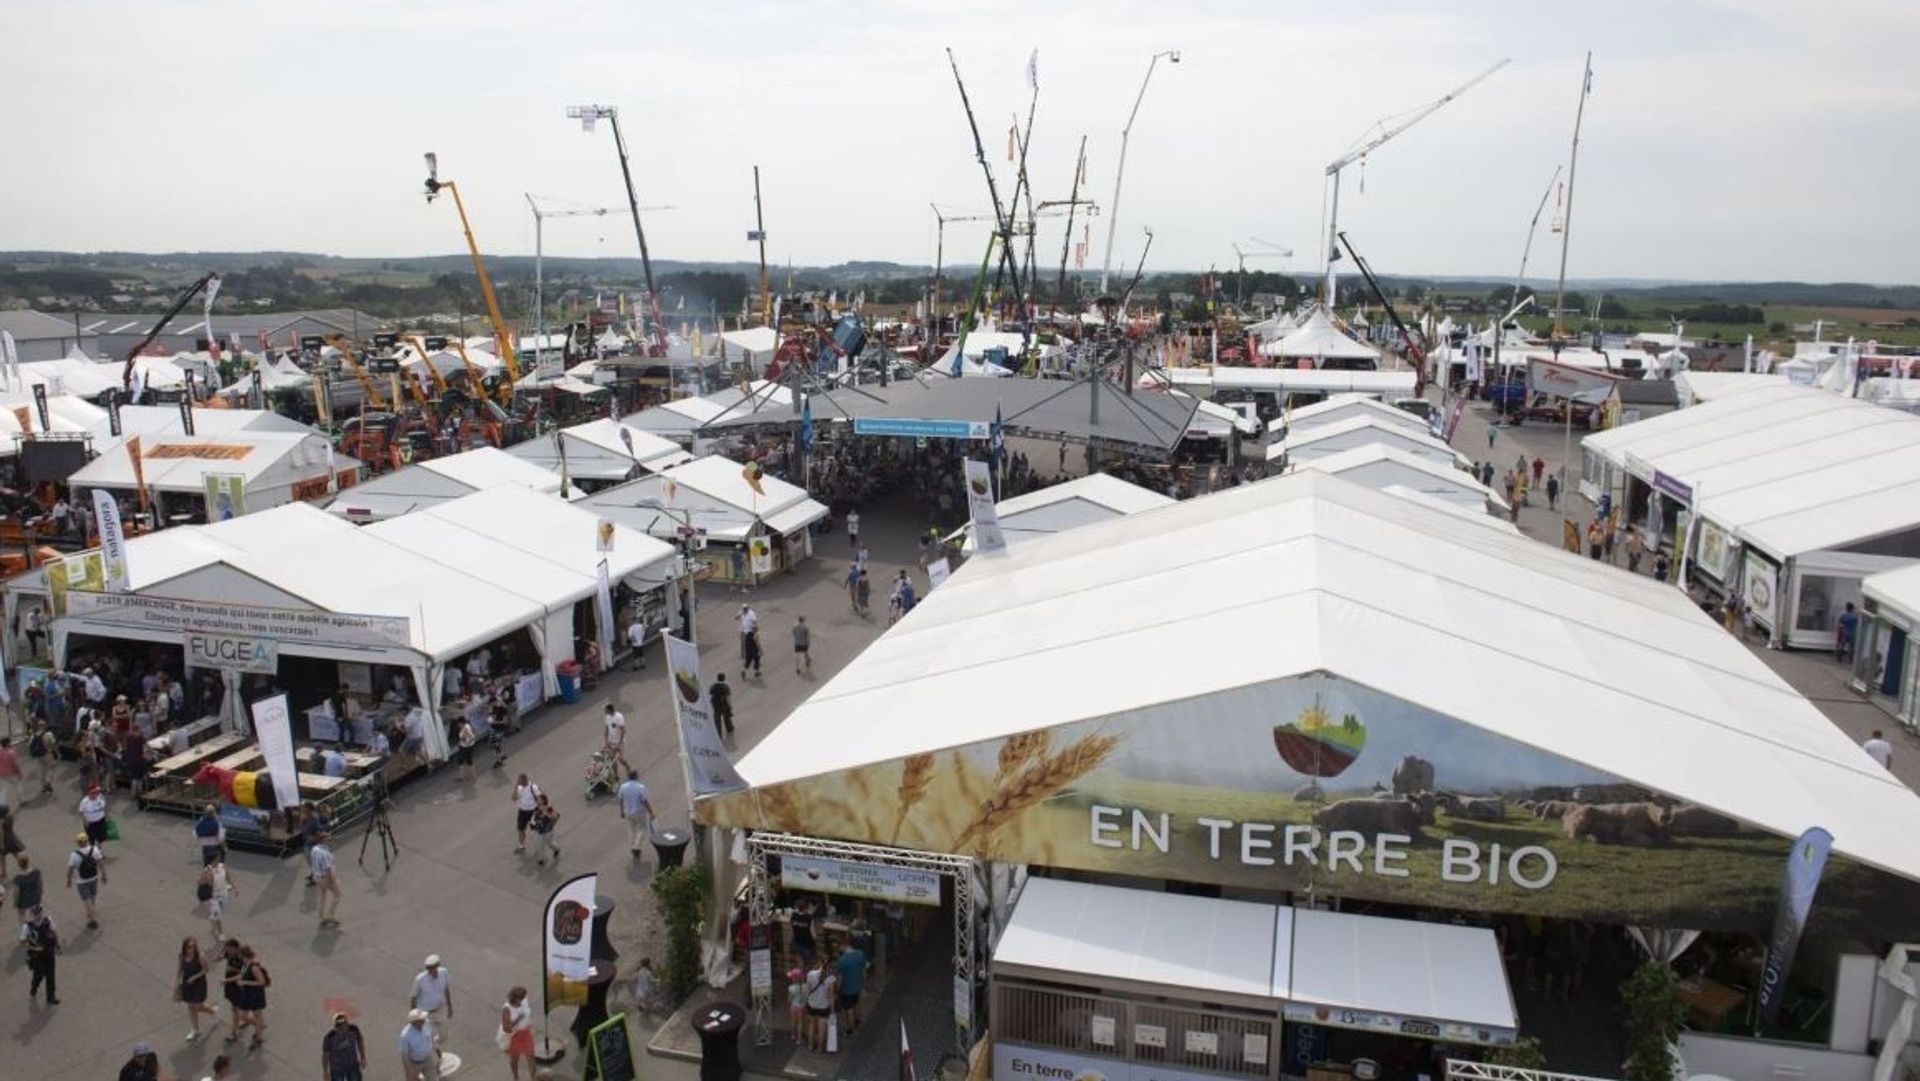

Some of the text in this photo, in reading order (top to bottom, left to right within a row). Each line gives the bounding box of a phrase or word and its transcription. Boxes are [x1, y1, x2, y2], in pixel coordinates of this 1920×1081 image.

[100, 501, 119, 559] natagora
[191, 637, 268, 662] FUGEA
[1091, 805, 1558, 889] EN TERRE BIO
[1011, 1058, 1074, 1080] En terre
